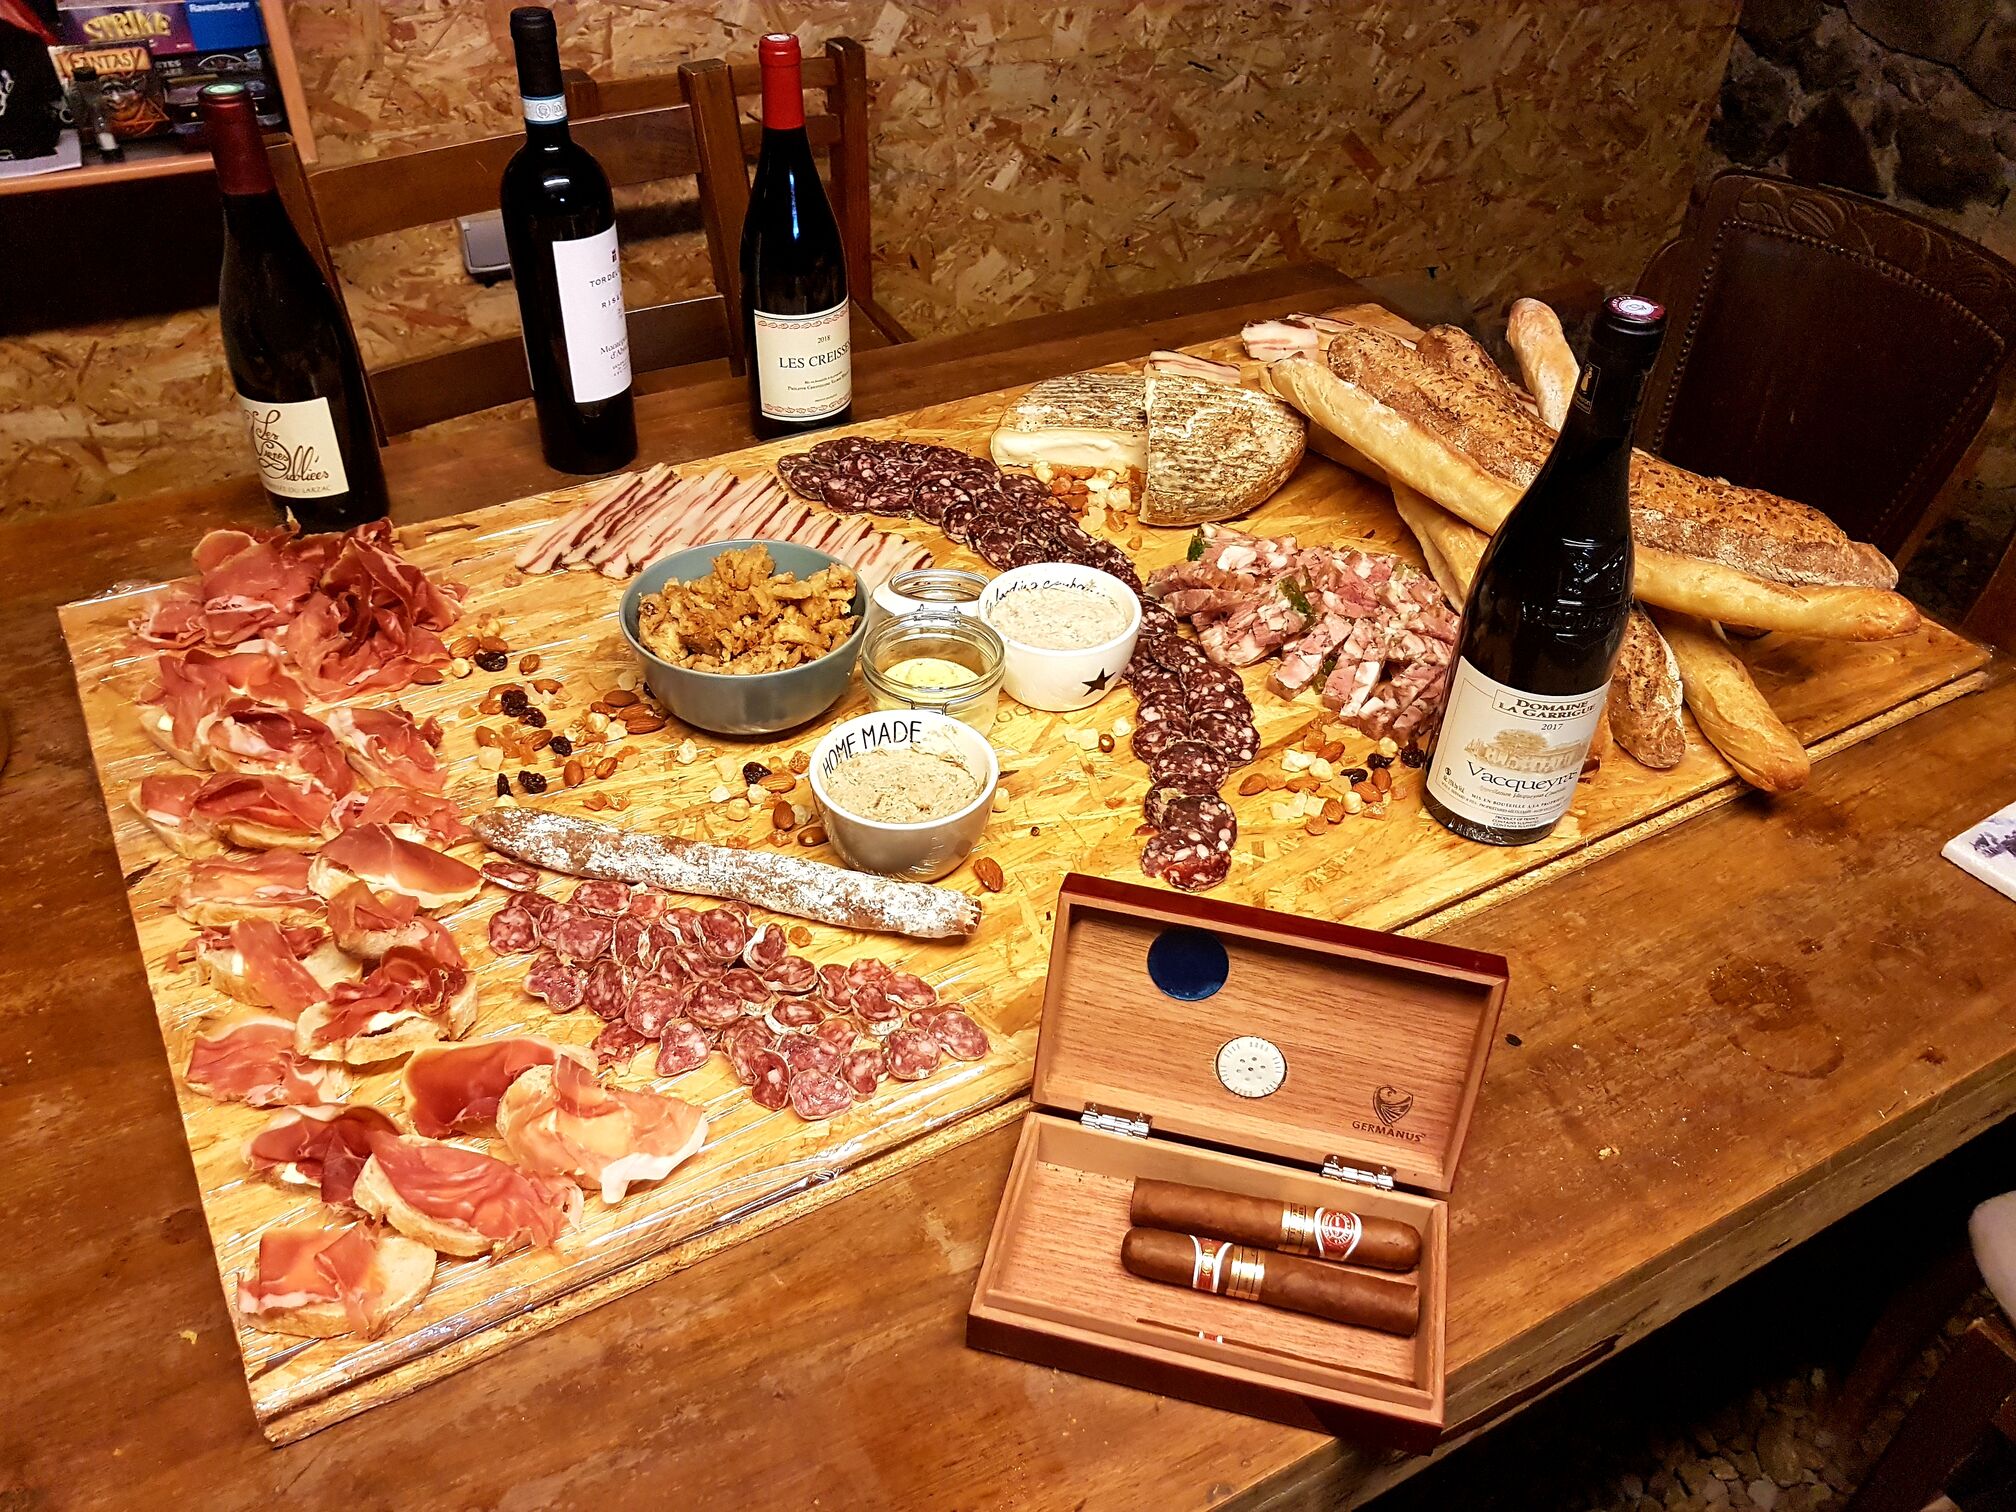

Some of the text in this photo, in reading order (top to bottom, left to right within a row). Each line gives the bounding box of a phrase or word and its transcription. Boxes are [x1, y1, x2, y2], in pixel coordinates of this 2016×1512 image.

[82, 9, 171, 40] STRIKE
[817, 335, 831, 344] 2018
[779, 357, 805, 369] LES
[1498, 701, 1597, 719] LA GARRIGUE
[1516, 699, 1589, 712] DOMAINE
[1541, 723, 1564, 731] 2017
[821, 720, 923, 778] HOME MADE
[1352, 1120, 1424, 1142] GERMANUS
